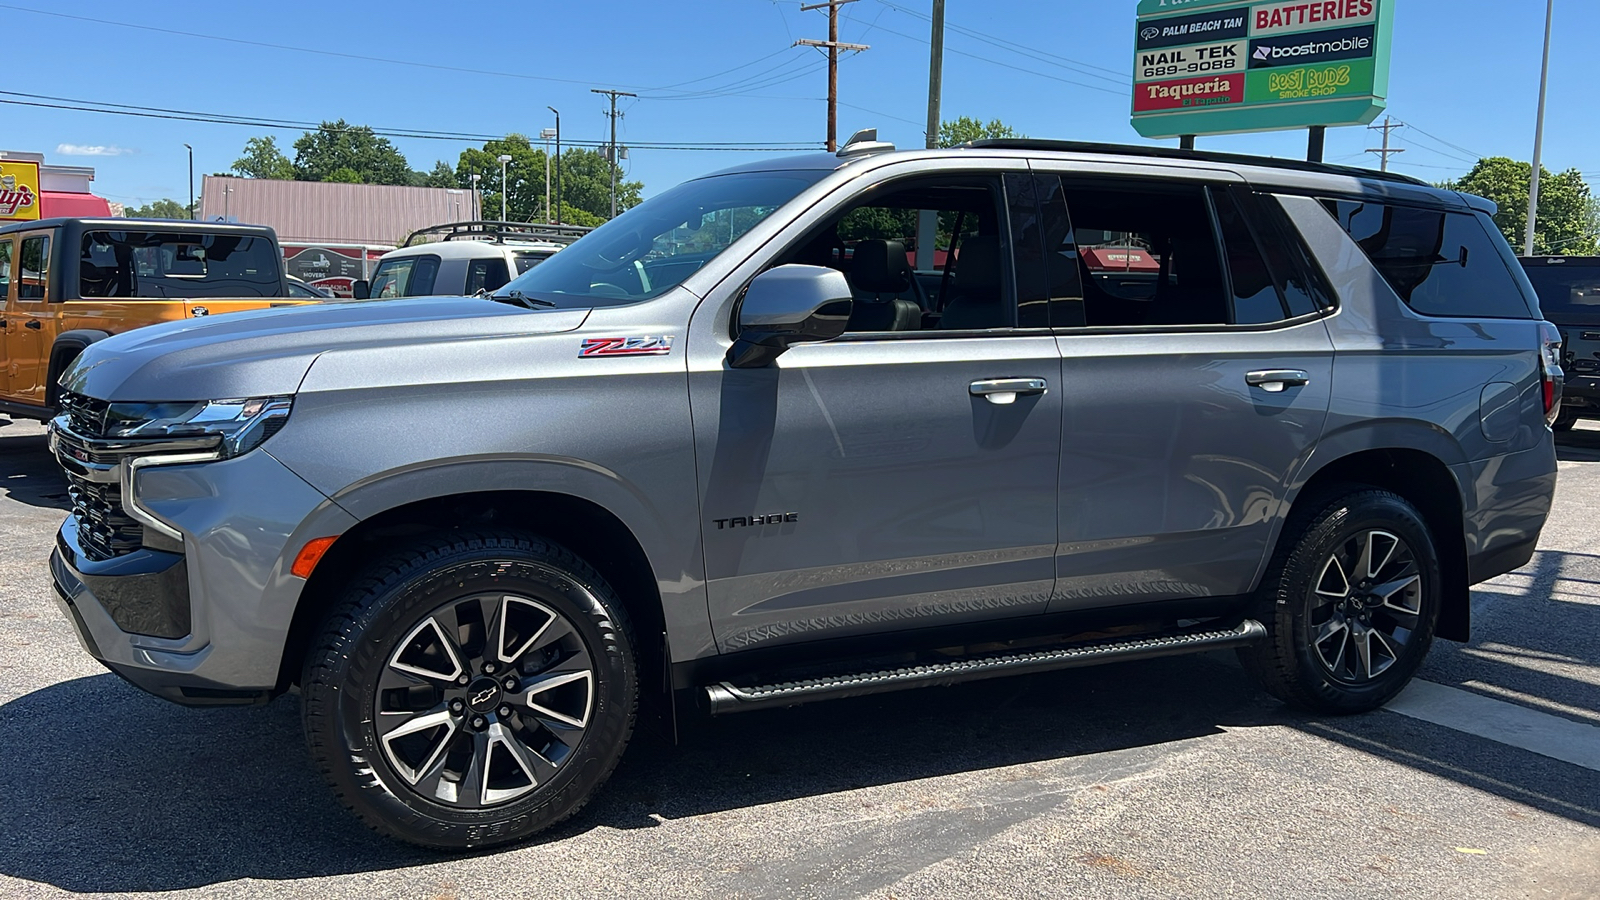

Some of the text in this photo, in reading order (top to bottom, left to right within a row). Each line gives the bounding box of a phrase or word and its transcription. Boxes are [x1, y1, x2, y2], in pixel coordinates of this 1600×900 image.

[1256, 0, 1373, 29] BATTERIES
[1162, 17, 1243, 37] PALM BEACH TAN
[1142, 44, 1238, 66] NAIL TEK
[1272, 37, 1369, 58] boostmobile
[1143, 59, 1235, 77] 689-9088
[1307, 65, 1350, 89] BUDZ
[1147, 77, 1231, 100] Taqueria
[1279, 87, 1336, 99] SMOKE SHOP
[1182, 98, 1192, 106] El
[713, 511, 798, 530] TAHOE
